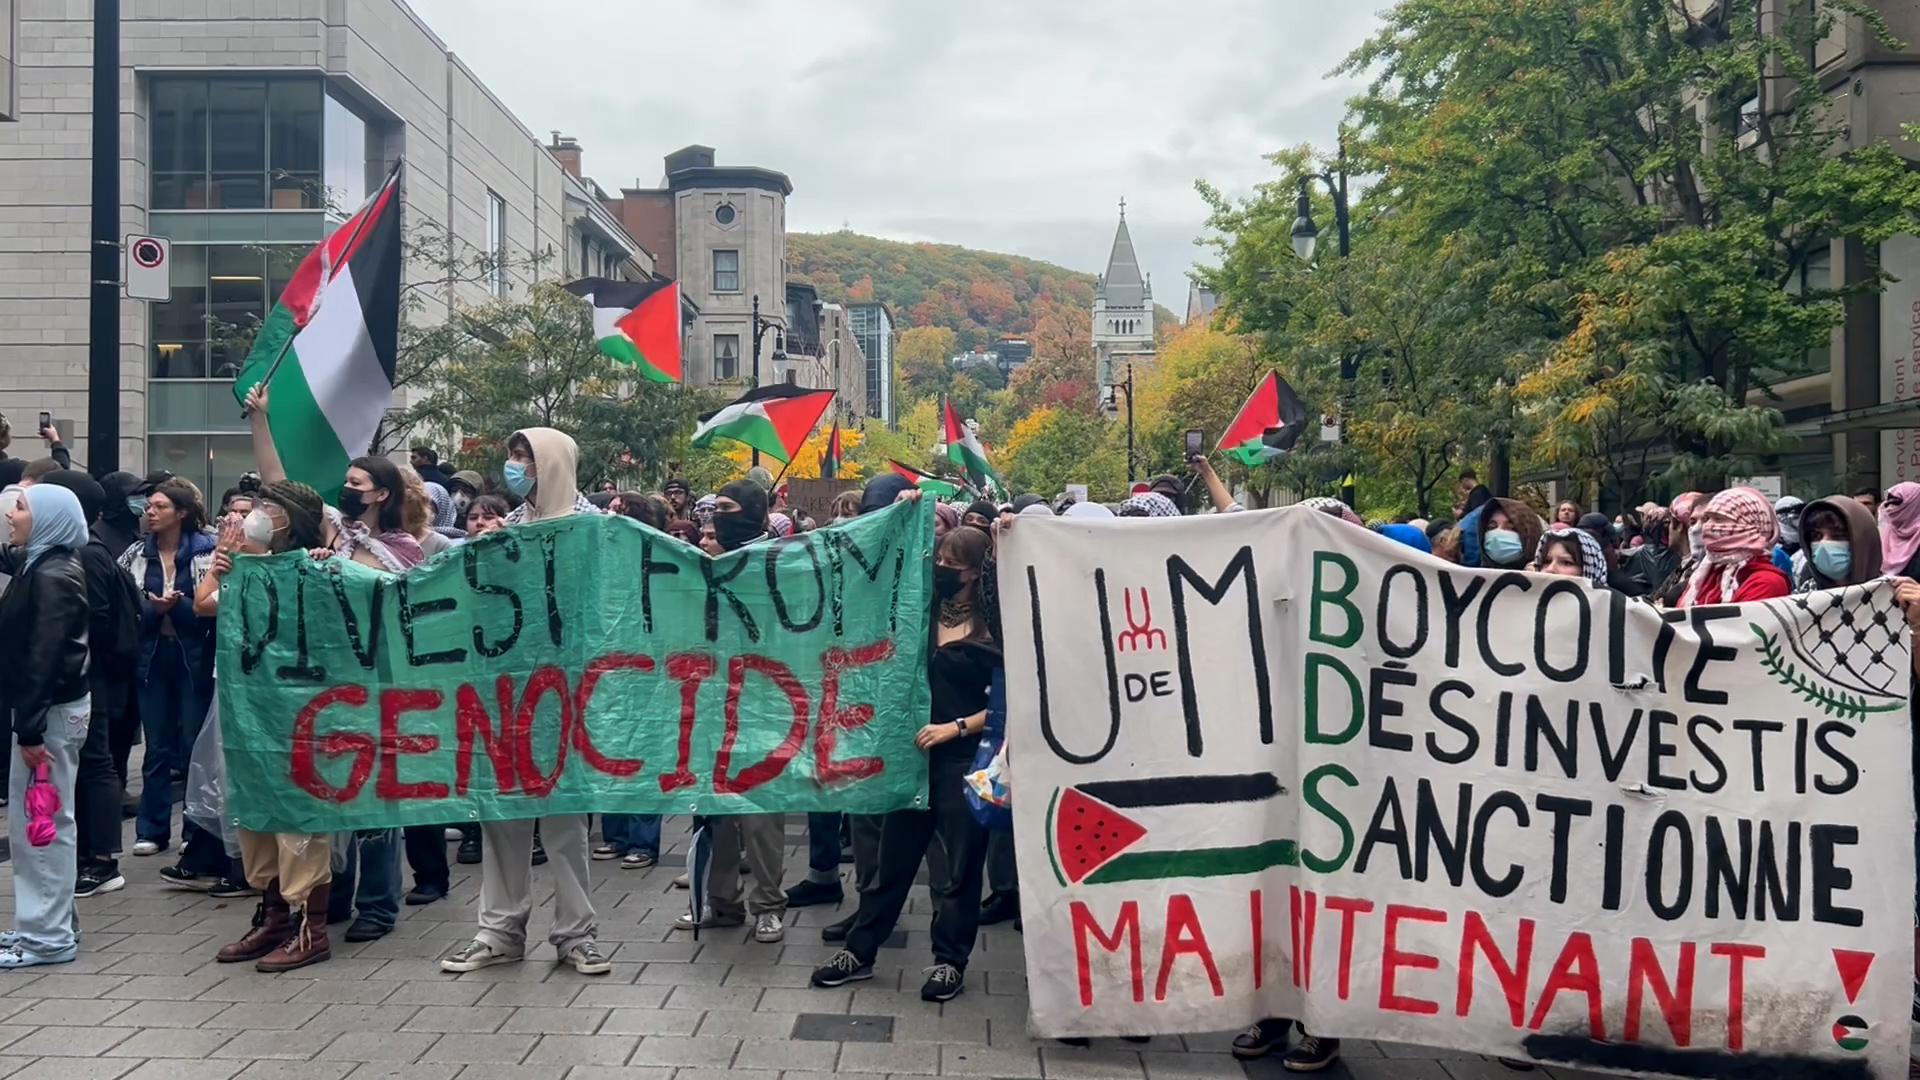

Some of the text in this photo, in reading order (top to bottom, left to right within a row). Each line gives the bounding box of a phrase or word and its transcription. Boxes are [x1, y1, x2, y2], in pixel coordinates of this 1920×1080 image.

[240, 518, 906, 684] DIVEST FROM
[290, 638, 897, 803] GENOCIDE
[1123, 669, 1176, 703] DE
[1304, 651, 1859, 796] DÉSINVESTIS
[1300, 762, 1865, 928] SANCTIONNE
